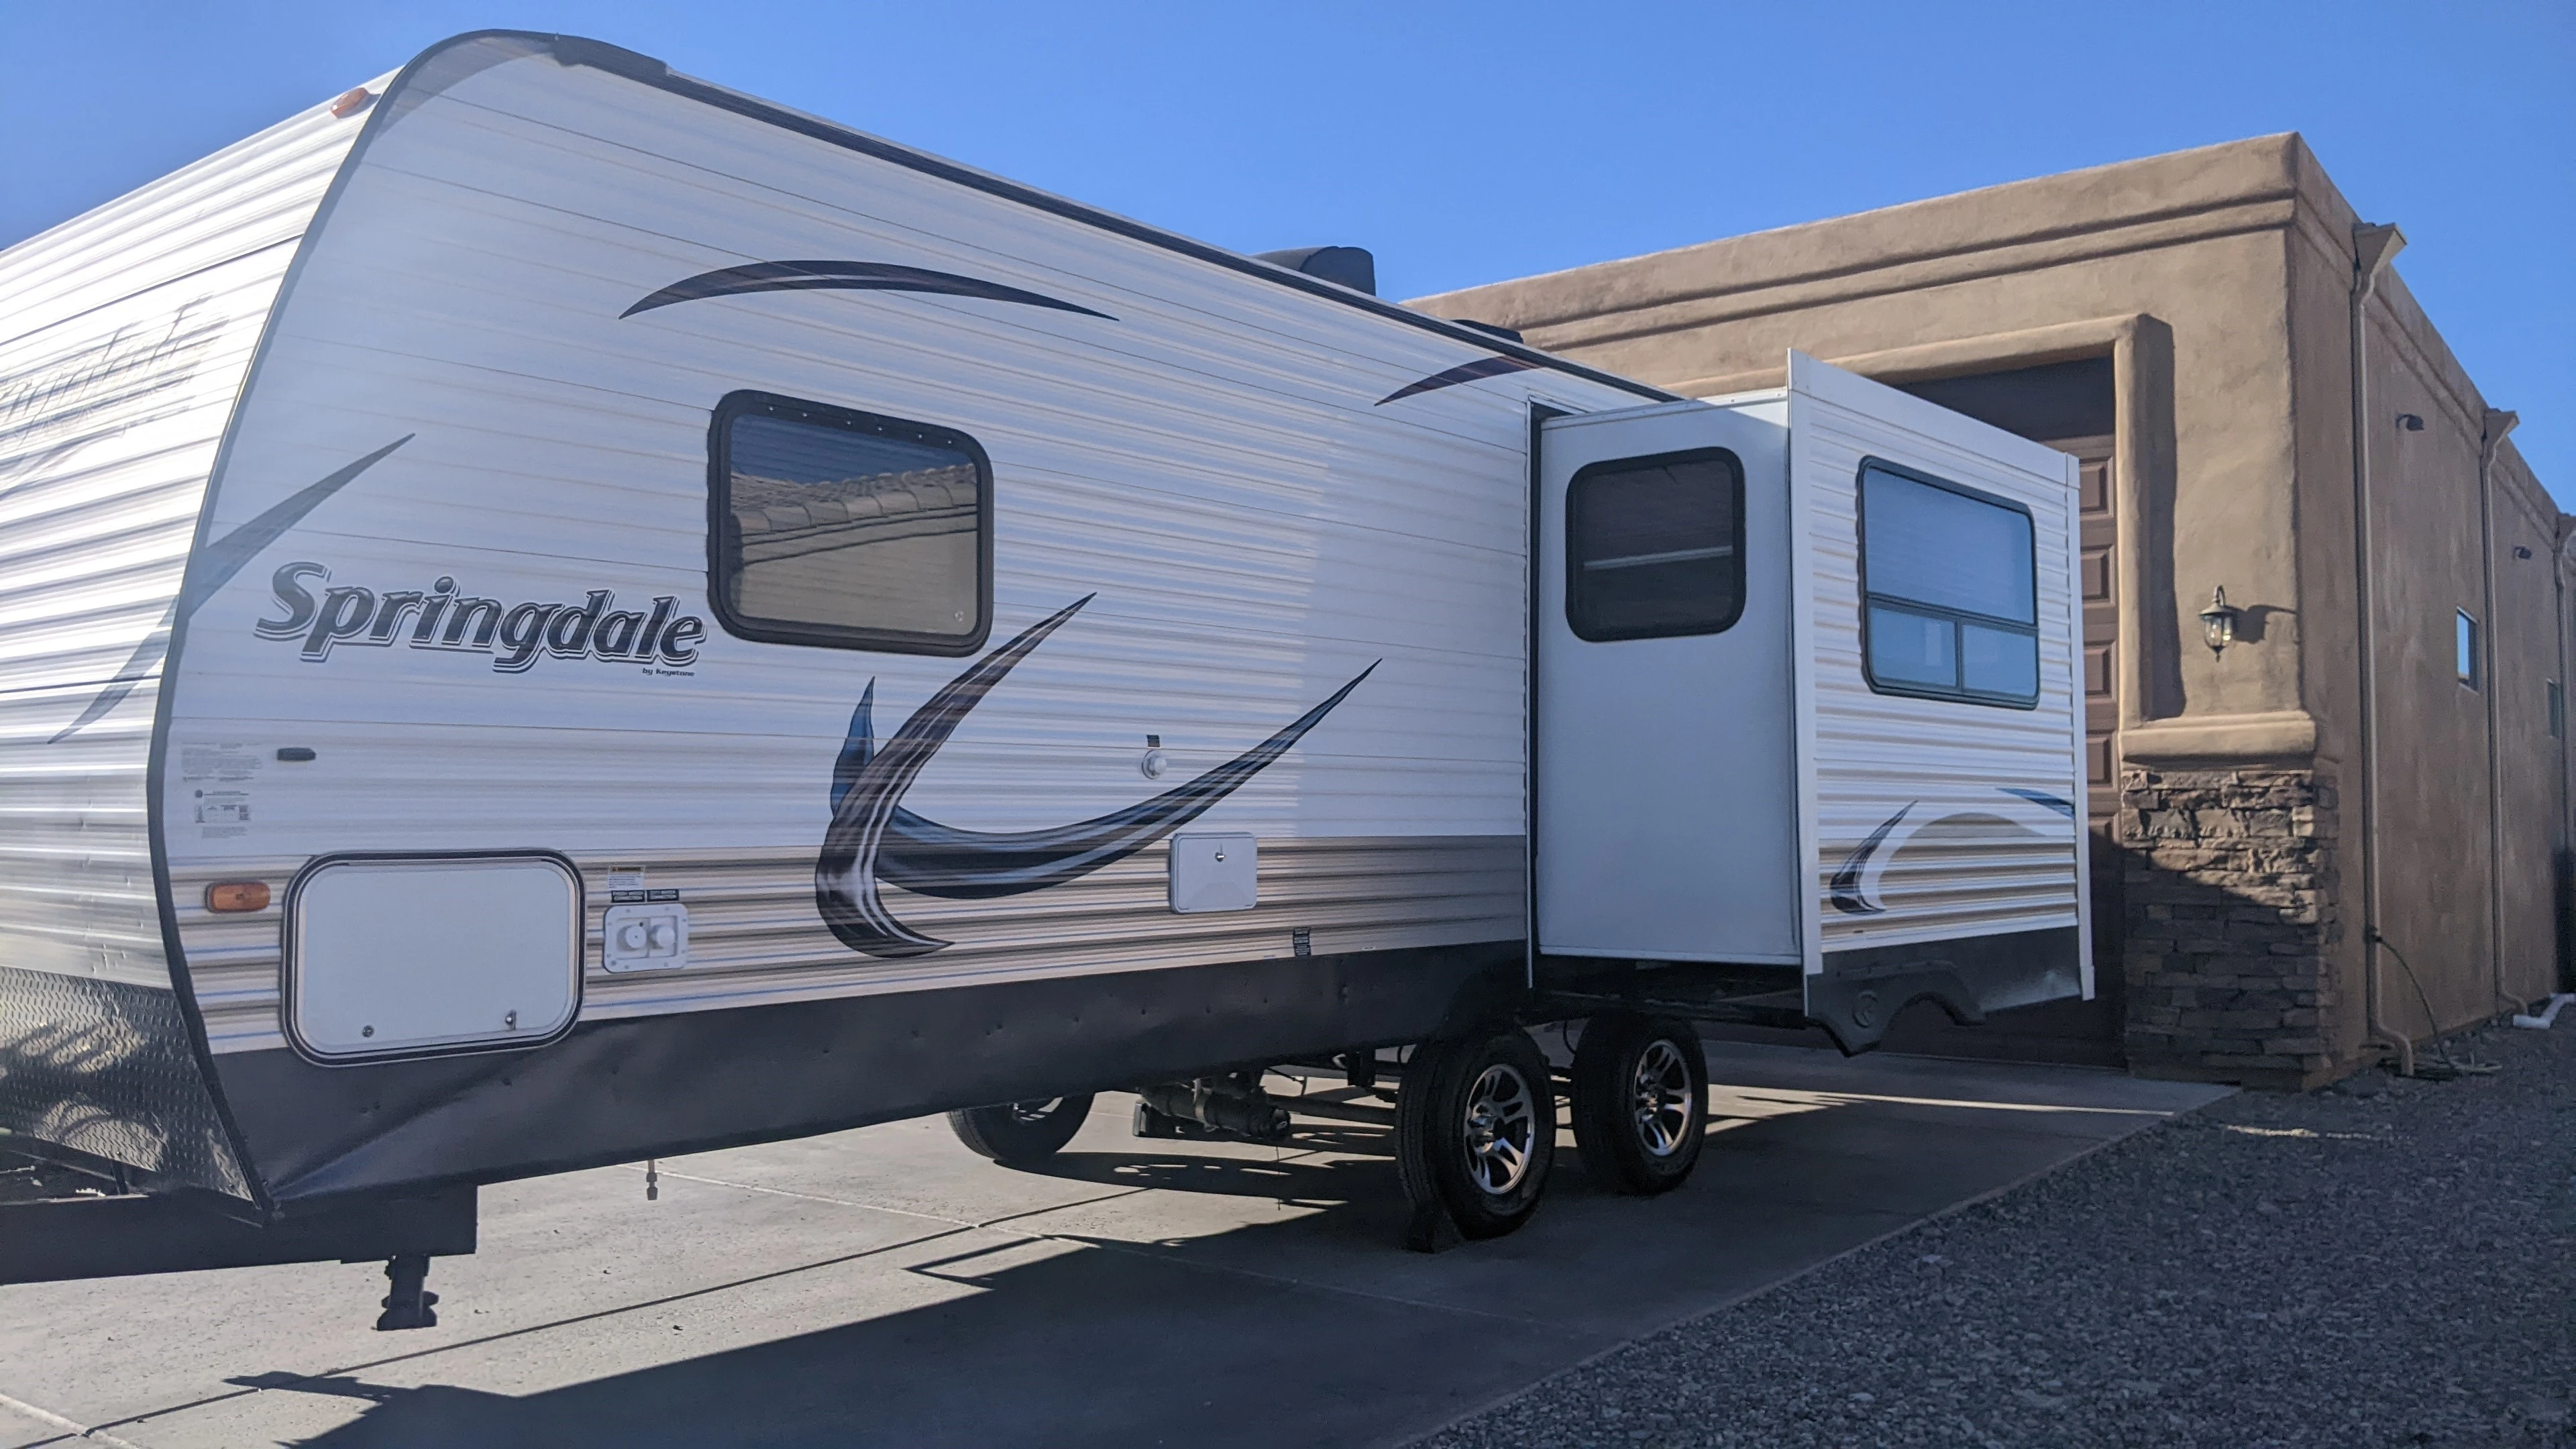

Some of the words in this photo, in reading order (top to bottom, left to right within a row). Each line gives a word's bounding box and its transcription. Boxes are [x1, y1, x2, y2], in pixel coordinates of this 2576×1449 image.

[254, 561, 706, 674] Springdale
[642, 667, 653, 676] by
[655, 668, 695, 677] Keystone
